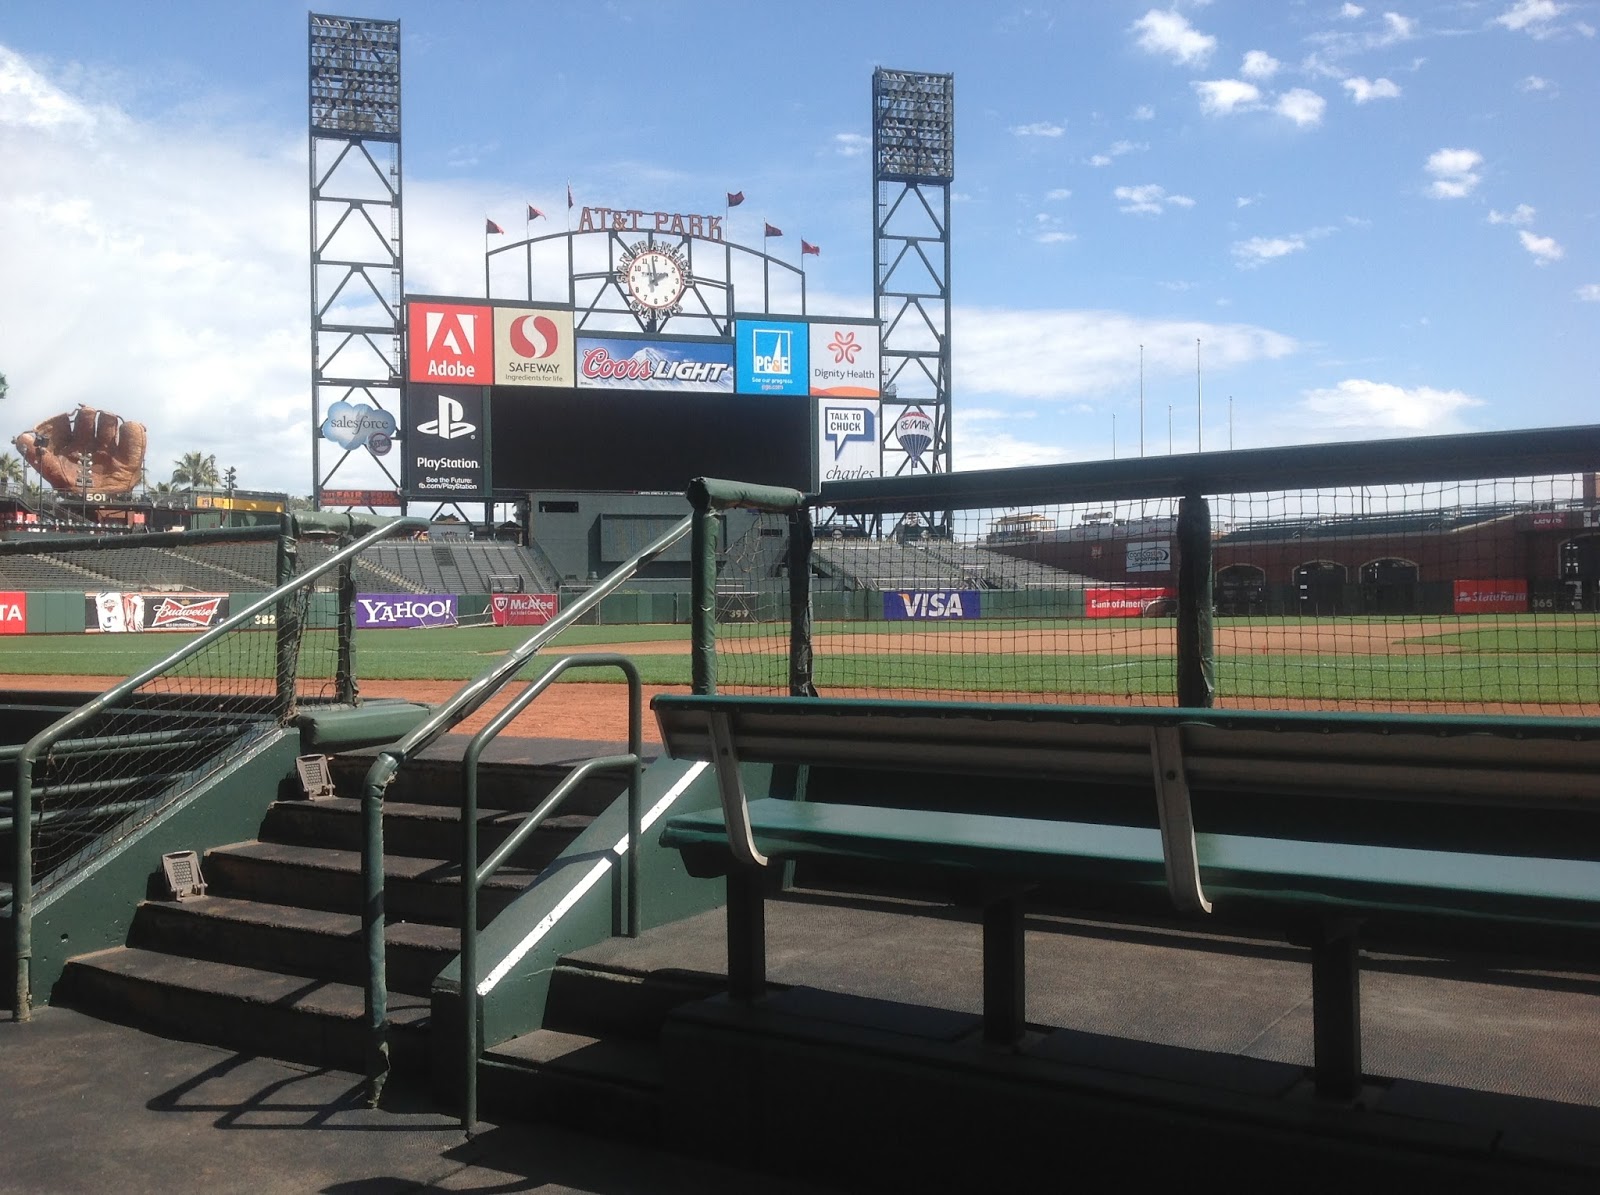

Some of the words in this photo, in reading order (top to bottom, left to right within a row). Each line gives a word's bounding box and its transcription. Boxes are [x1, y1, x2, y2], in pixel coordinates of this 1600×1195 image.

[578, 207, 643, 232] AT&T
[654, 212, 722, 240] PARK
[630, 240, 695, 286] FRANCISCO
[629, 299, 683, 320] GIANTS
[428, 360, 475, 377] Adobe
[509, 362, 560, 373] SAFEWAY
[582, 347, 653, 381] Coors
[652, 360, 728, 382] LIGHT
[755, 355, 789, 372] PG&E
[505, 374, 541, 382] Ingredients
[814, 368, 845, 380] Dignity
[847, 370, 875, 378] Health
[830, 412, 849, 420] TALK
[330, 414, 389, 434] salesforce
[830, 422, 861, 431] CHUCK
[901, 419, 931, 429] RE/MAX
[417, 457, 478, 471] PlayStation
[826, 465, 874, 480] charles
[418, 482, 477, 490] fb.com/PlayStation
[86, 493, 106, 502] 501
[510, 599, 553, 610] McAfee
[898, 593, 963, 617] VISA
[1091, 599, 1110, 608] Bank
[1112, 599, 1120, 608] of
[1532, 599, 1553, 608] 365
[153, 604, 217, 618] Budweiser
[358, 599, 452, 623] YAHOO!
[729, 609, 749, 618] 399
[255, 614, 275, 625] 382
